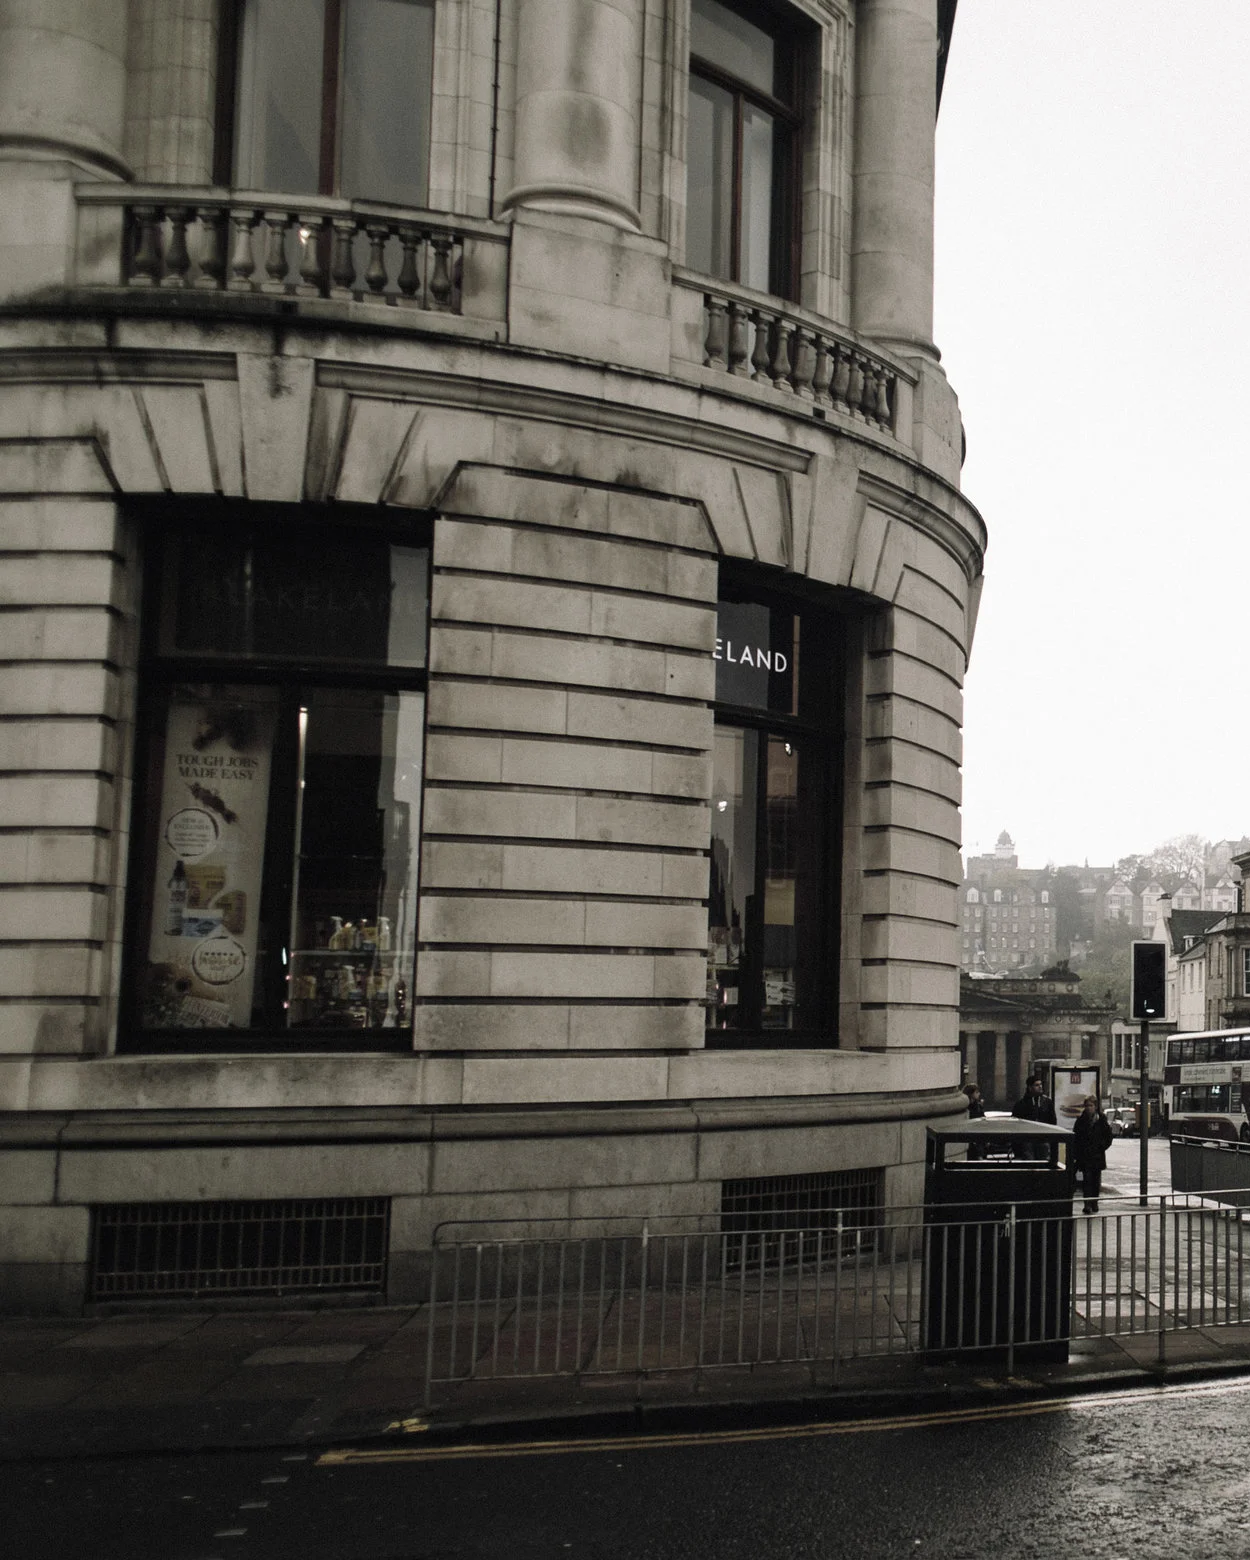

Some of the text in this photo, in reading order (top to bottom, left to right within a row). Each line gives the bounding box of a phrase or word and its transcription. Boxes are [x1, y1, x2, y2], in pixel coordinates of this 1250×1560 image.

[712, 638, 787, 672] ELAND
[177, 754, 259, 768] TOUGH JOBS
[178, 767, 254, 780] MADE EASY
